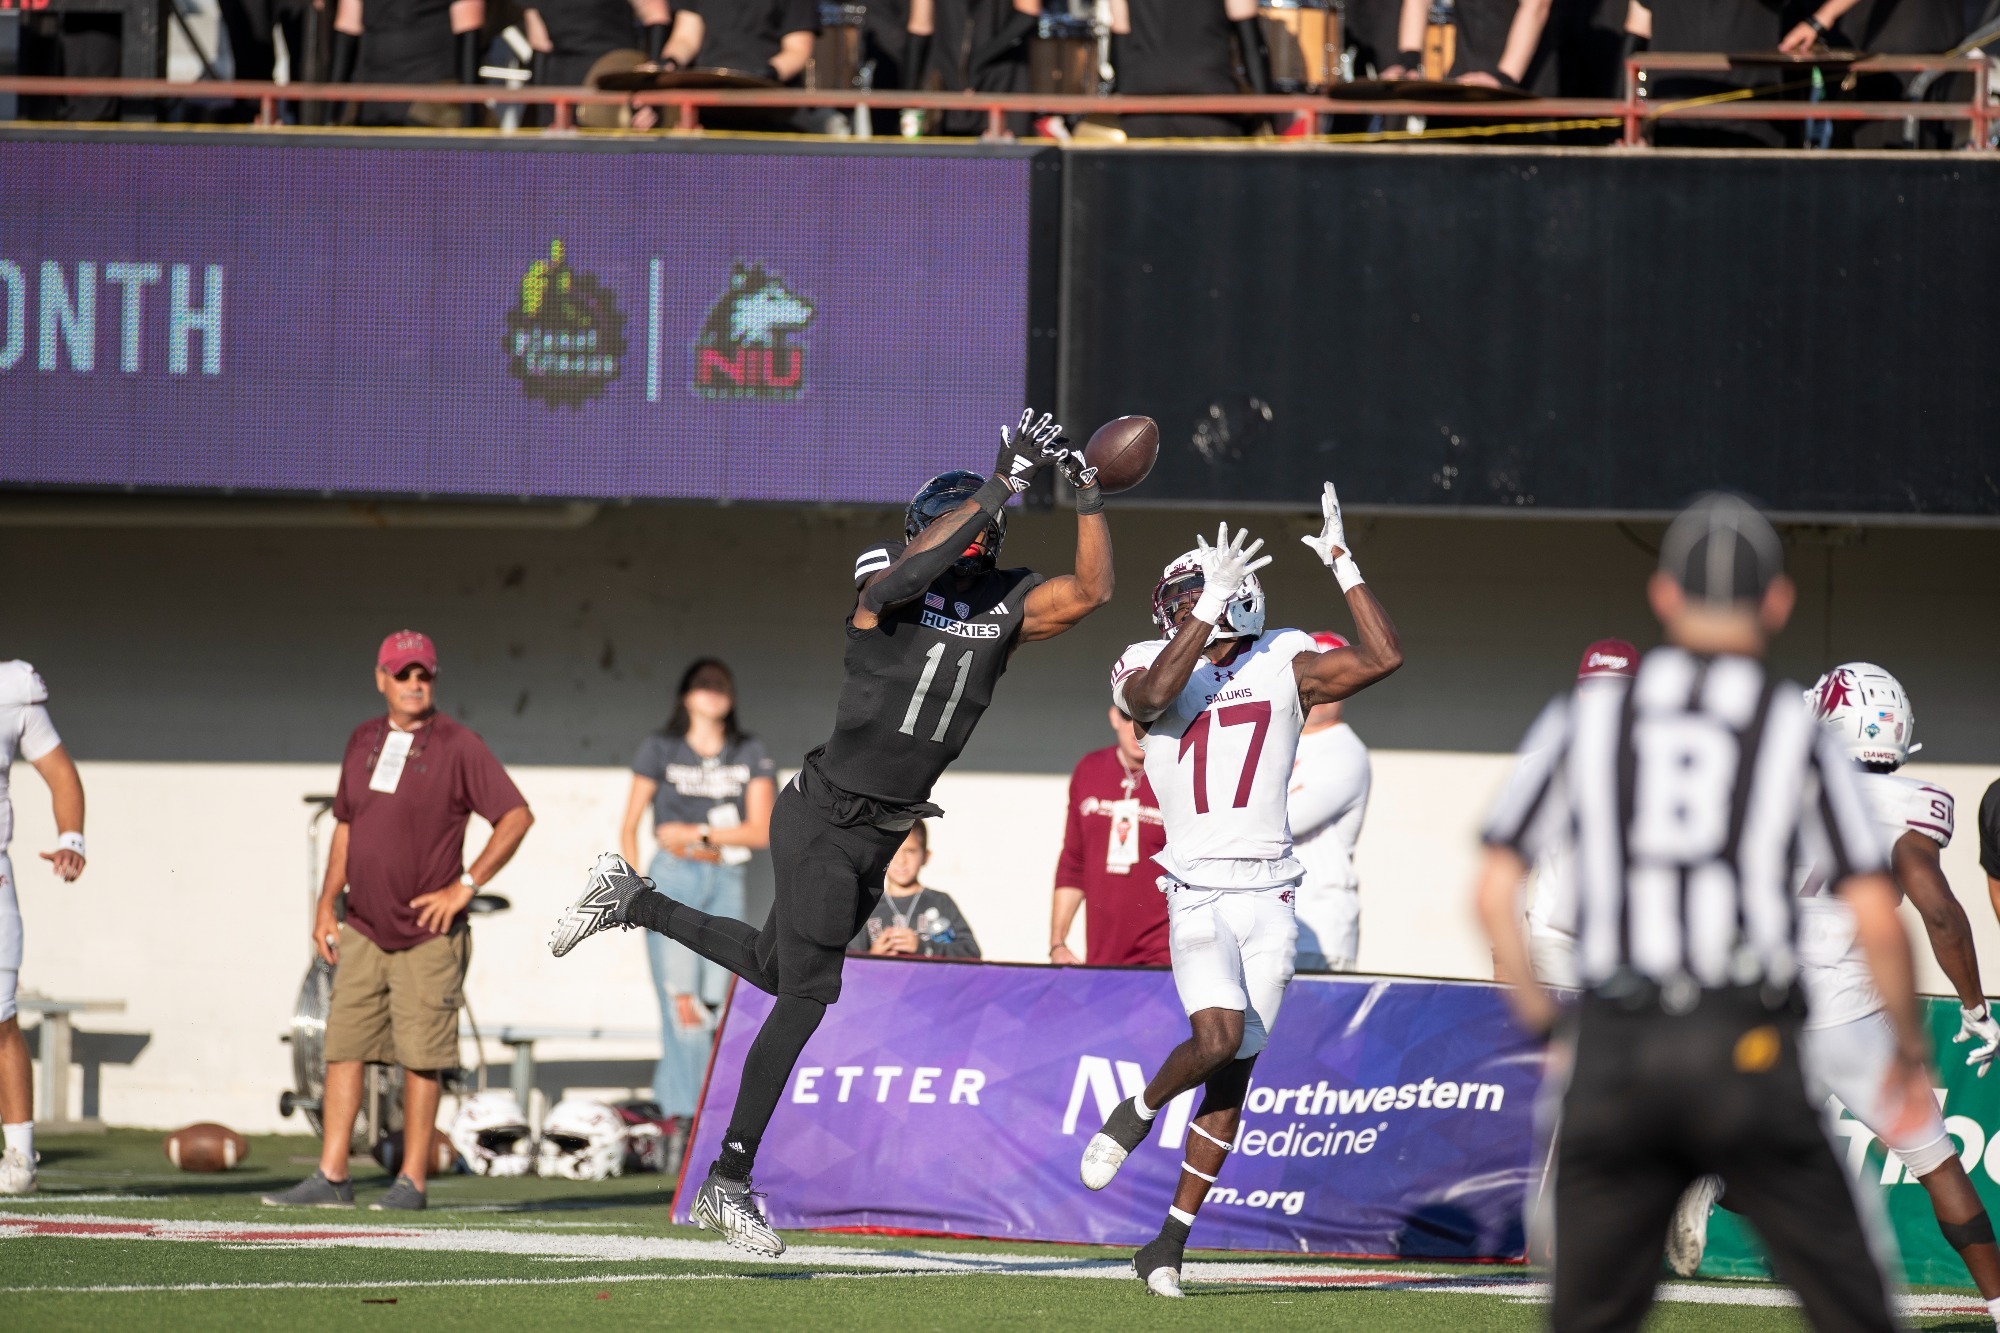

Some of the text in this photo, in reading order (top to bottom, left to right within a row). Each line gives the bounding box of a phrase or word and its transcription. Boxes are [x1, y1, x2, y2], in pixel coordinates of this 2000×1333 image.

[699, 349, 800, 386] NIU
[921, 611, 999, 637] HUSKIES
[898, 642, 974, 743] 11
[1204, 688, 1252, 704] SALUKIS
[1178, 700, 1271, 814] 17
[792, 1066, 985, 1106] ETTER
[1242, 1077, 1504, 1115] orthwestern
[1203, 1186, 1305, 1215] m.org
